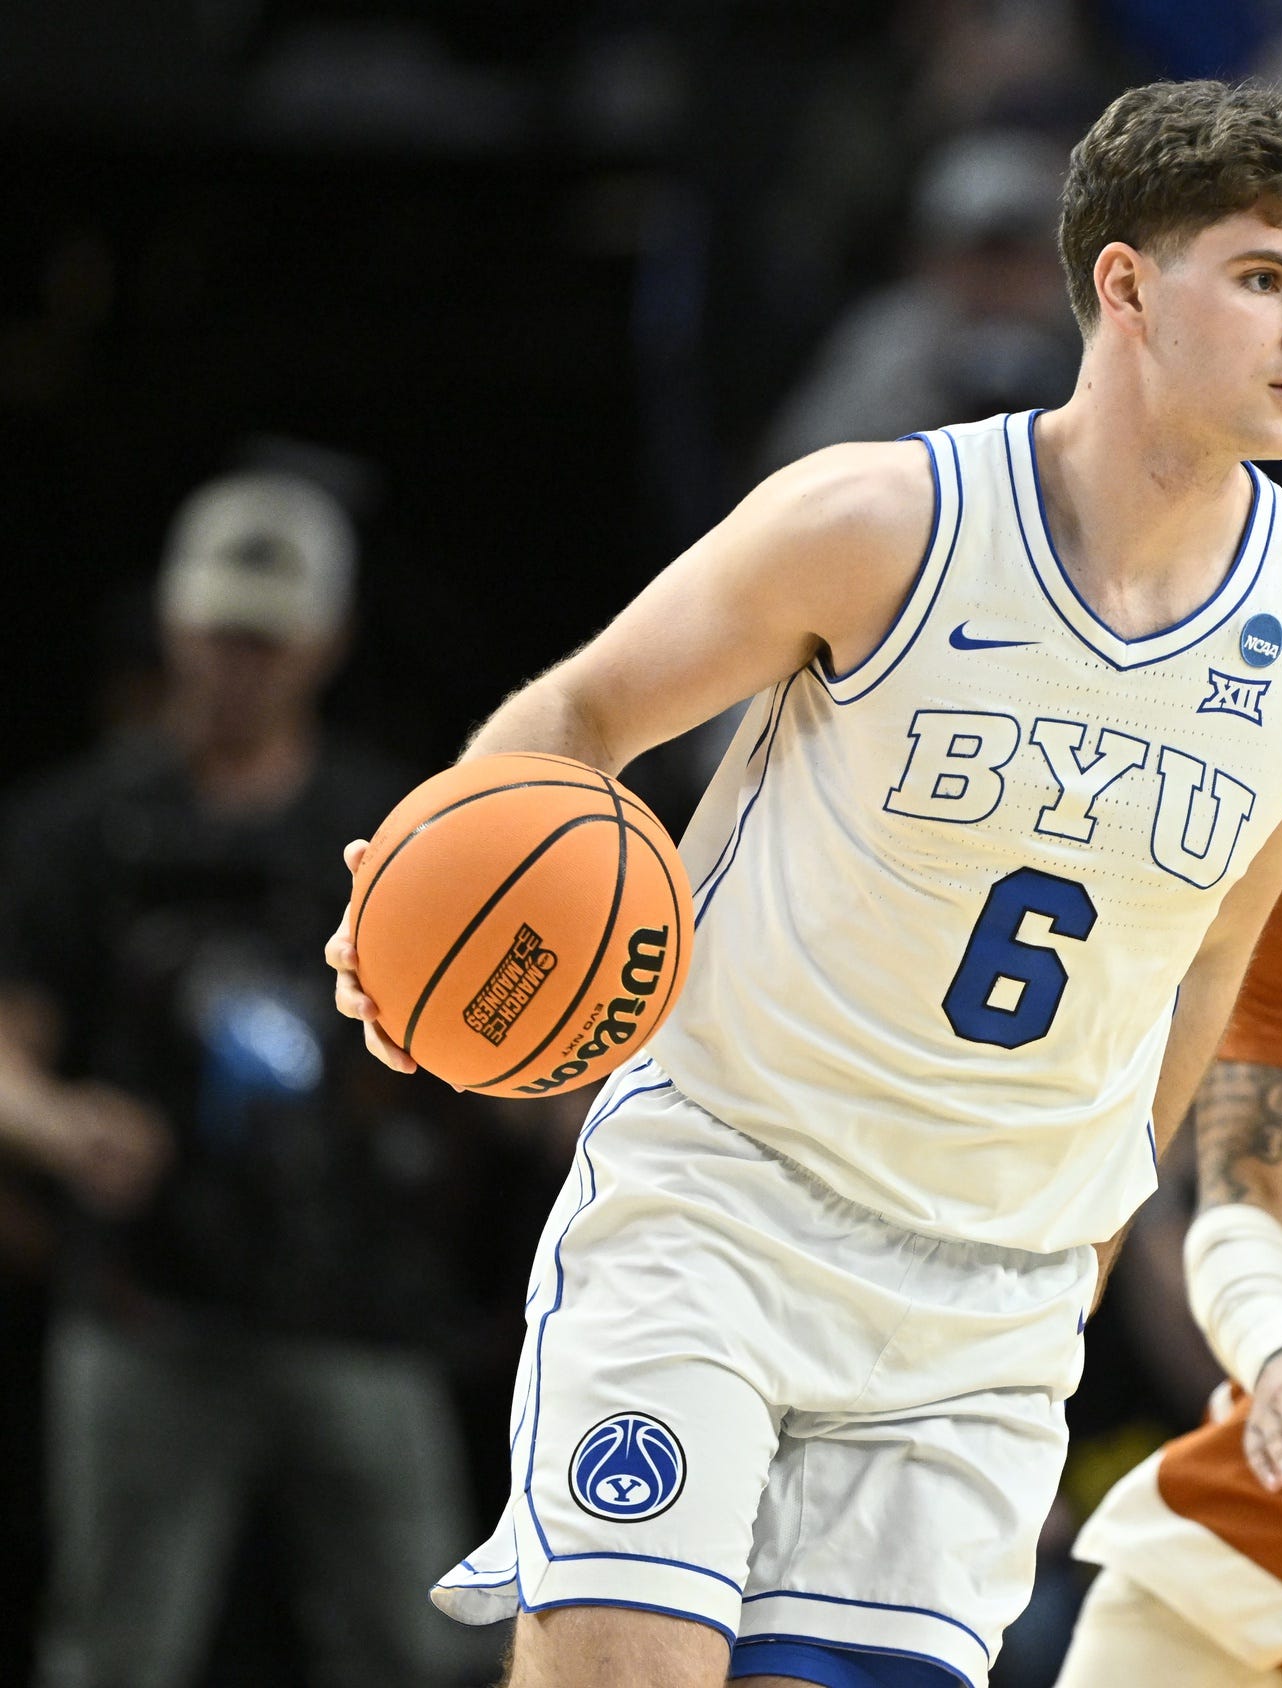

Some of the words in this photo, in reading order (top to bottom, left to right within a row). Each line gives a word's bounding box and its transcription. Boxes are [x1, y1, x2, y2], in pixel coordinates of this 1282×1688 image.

[1244, 634, 1280, 659] NCAA
[883, 709, 1256, 889] BYU
[941, 866, 1098, 1050] 6
[466, 959, 525, 1032] MADNESS
[498, 963, 545, 1022] MARCH
[512, 925, 669, 1094] Wilson
[584, 1003, 604, 1031] EVO
[561, 1033, 585, 1058] NXT
[606, 1477, 642, 1502] Y
